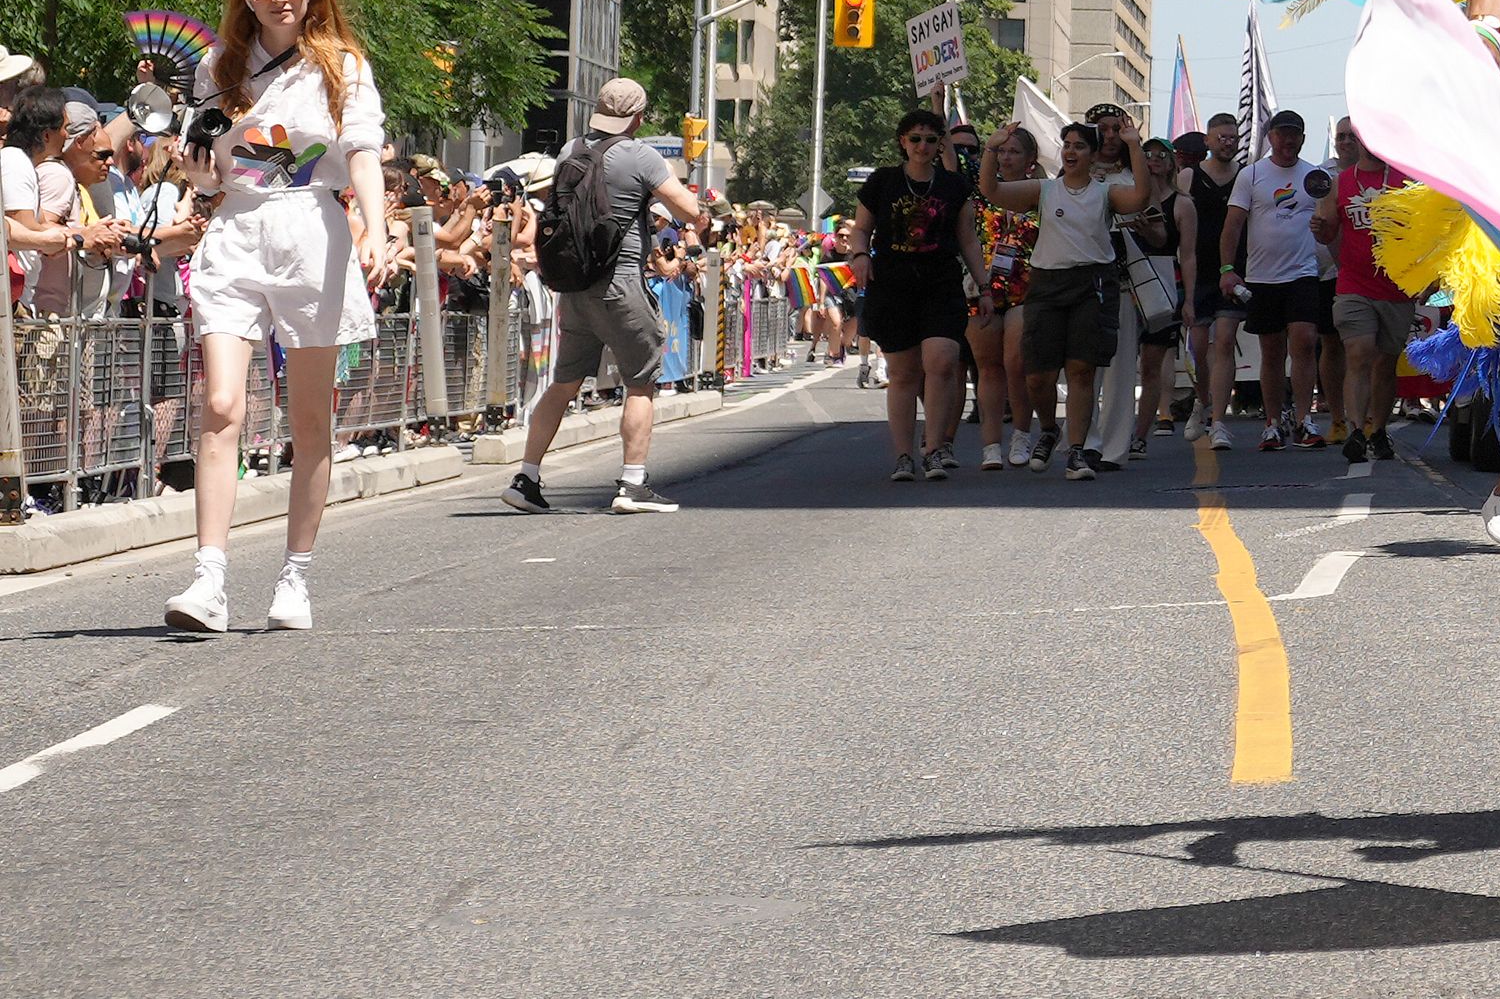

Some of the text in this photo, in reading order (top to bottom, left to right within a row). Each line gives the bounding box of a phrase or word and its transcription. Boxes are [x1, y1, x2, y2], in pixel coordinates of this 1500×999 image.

[911, 8, 953, 44] SAY GAY
[915, 36, 960, 74] LOUDER!
